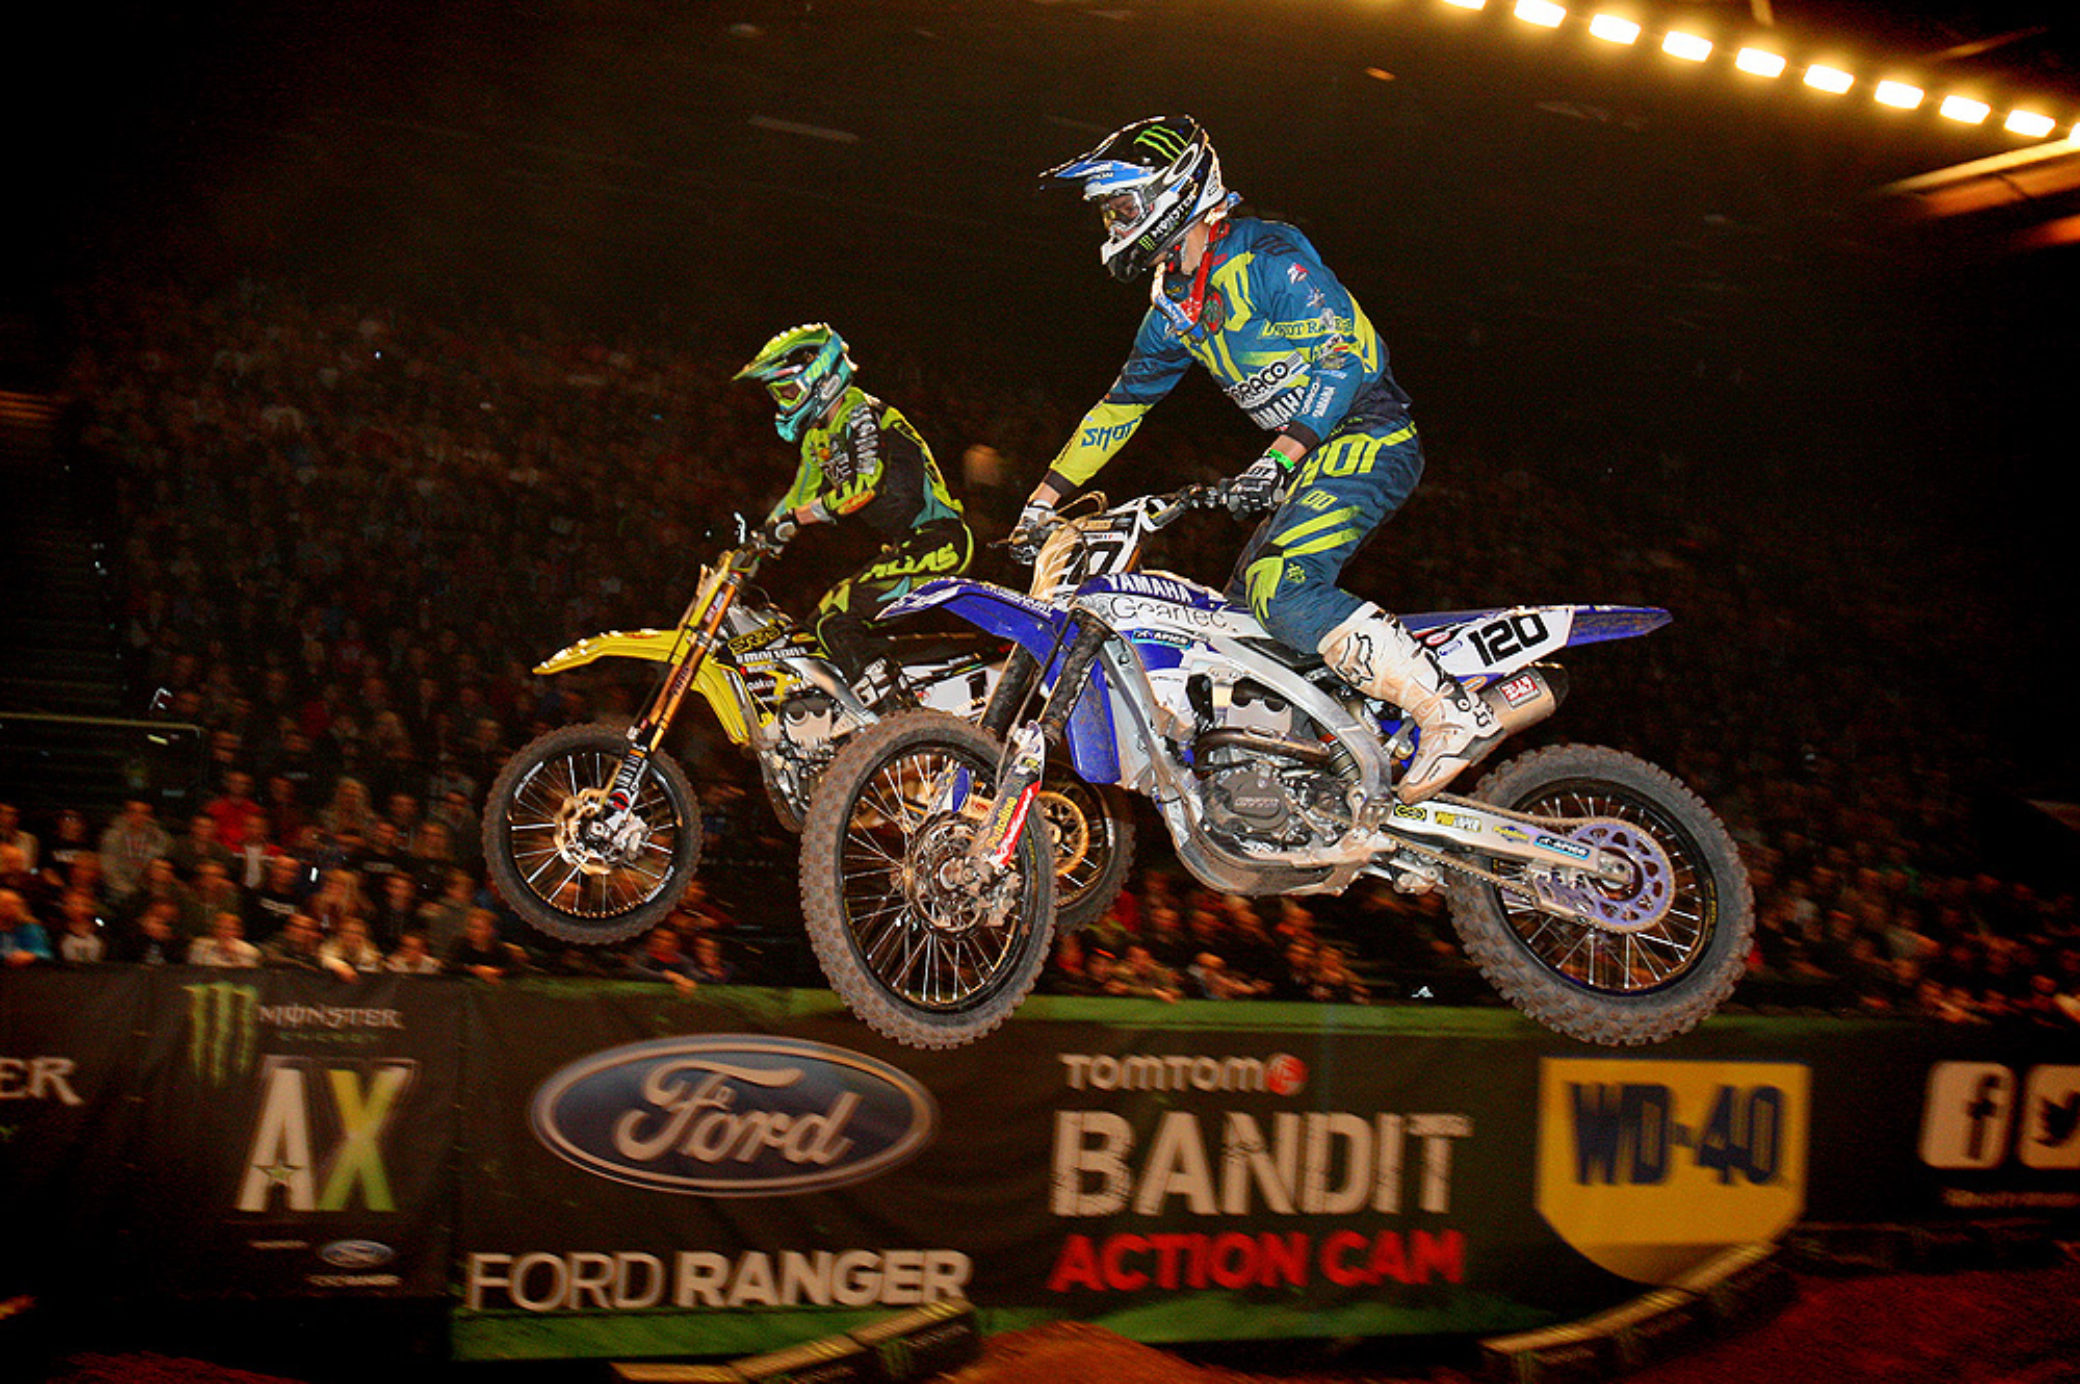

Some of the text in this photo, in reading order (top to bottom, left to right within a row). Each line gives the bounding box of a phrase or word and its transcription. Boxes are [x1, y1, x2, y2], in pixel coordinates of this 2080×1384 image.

[1081, 414, 1144, 451] SHOT
[1102, 573, 1192, 604] YAMAHA
[1111, 597, 1227, 628] Geartec
[1467, 613, 1550, 667] 120
[258, 1003, 405, 1029] MONSTER
[238, 1060, 415, 1212] AX
[613, 1060, 854, 1164] Ford
[1569, 1080, 1787, 1187] WD-40
[1048, 1111, 1475, 1217] BANDIT
[466, 1250, 666, 1312] FORD
[676, 1249, 973, 1309] RANGER
[1047, 1229, 1467, 1292] ACTION CAM
